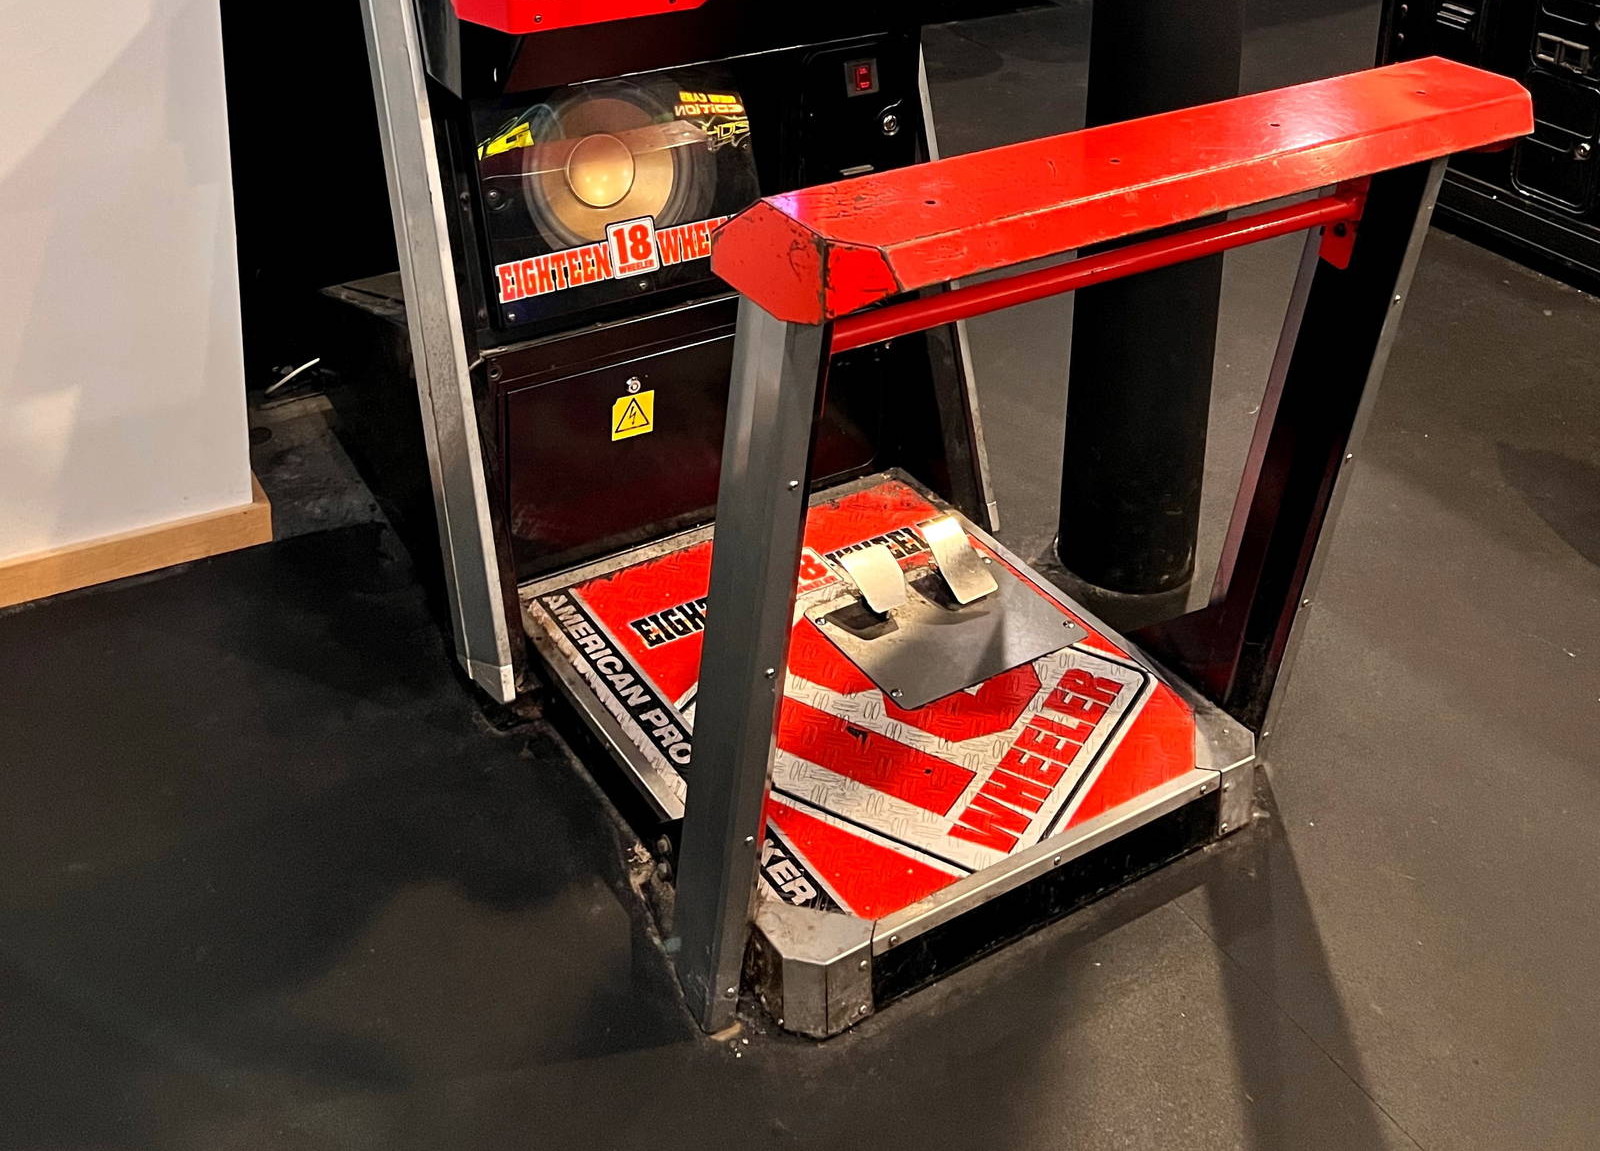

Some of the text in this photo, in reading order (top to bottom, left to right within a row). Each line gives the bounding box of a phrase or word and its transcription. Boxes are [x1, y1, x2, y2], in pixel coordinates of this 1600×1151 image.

[496, 242, 613, 303] EIGHTEEN
[612, 223, 654, 265] 18
[542, 594, 652, 707] AMERICAN
[639, 708, 692, 765] PRO
[629, 598, 707, 649] EIGH
[947, 668, 1125, 854] WHEELER
